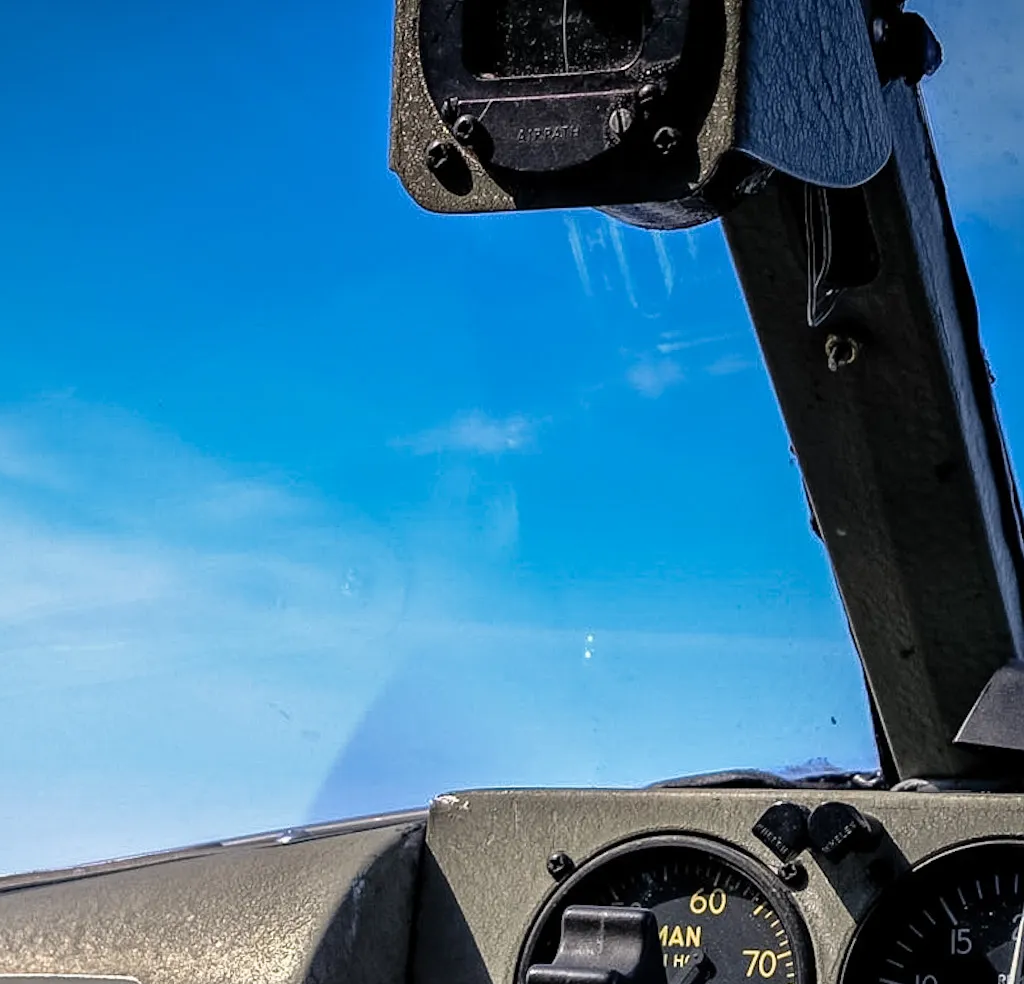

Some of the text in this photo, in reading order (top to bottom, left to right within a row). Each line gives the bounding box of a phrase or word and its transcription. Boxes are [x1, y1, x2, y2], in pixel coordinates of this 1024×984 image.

[689, 888, 727, 916] 60
[950, 928, 973, 955] 15
[742, 949, 777, 978] 70
